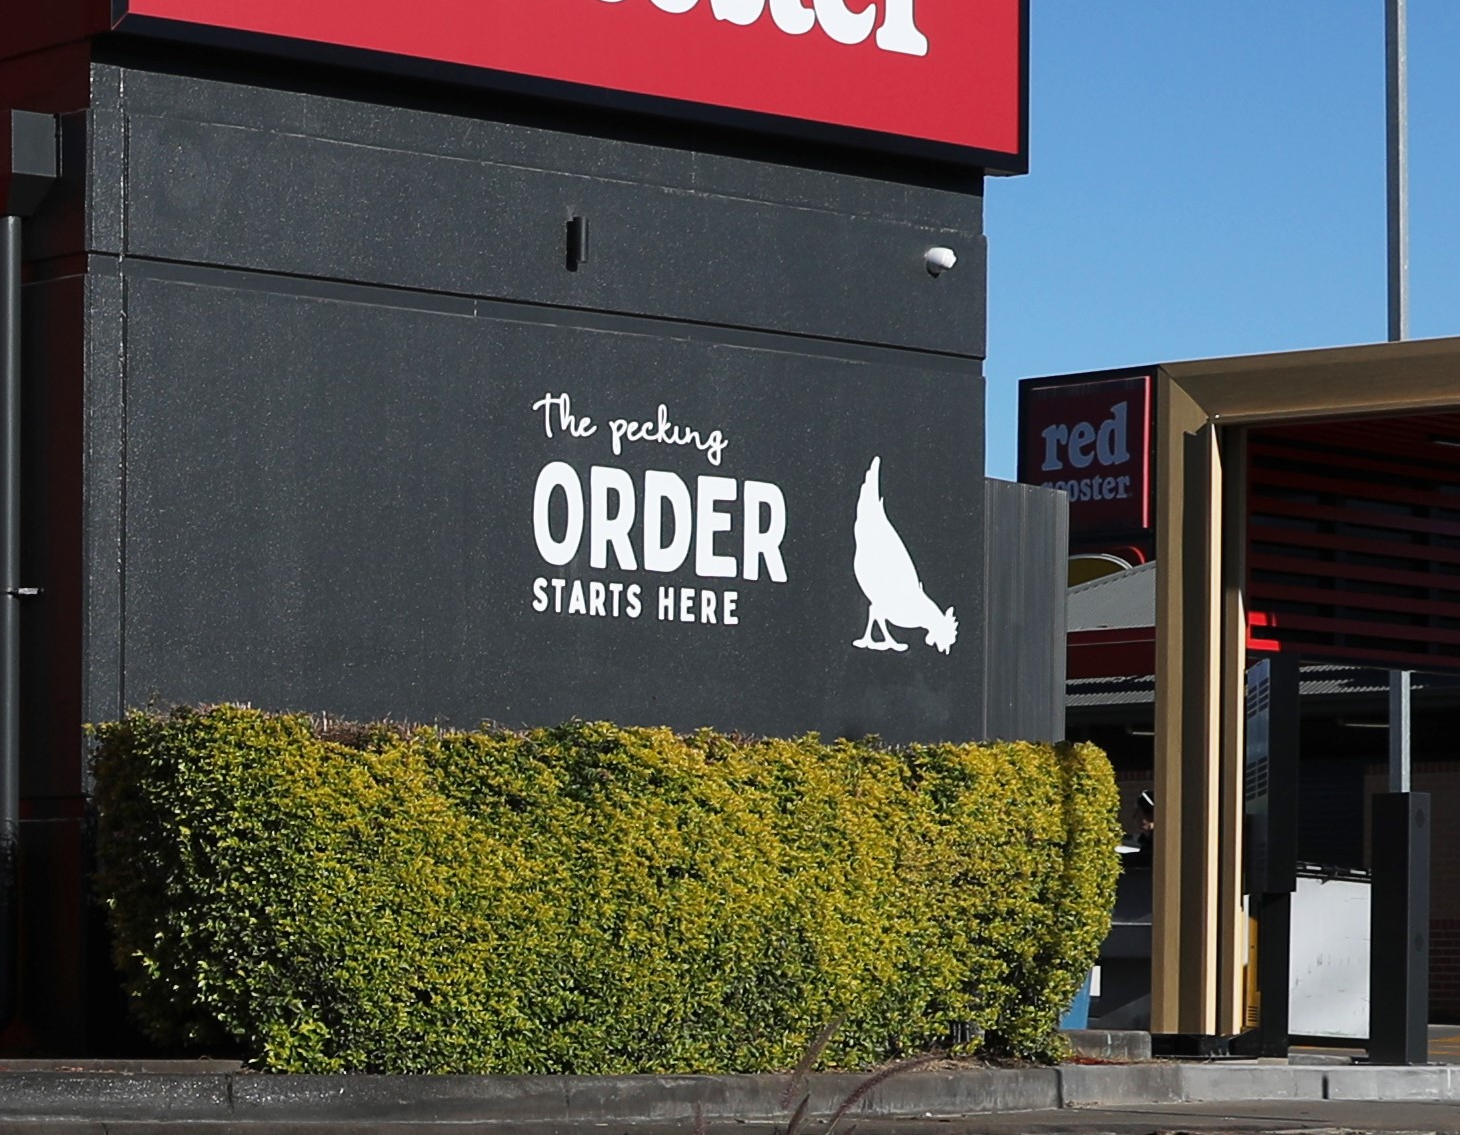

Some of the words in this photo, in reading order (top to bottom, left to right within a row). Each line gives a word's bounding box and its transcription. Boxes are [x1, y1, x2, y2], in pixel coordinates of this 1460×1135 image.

[532, 392, 598, 439] The
[608, 403, 730, 466] pecking
[1041, 400, 1131, 472] red
[532, 460, 789, 583] ORDER
[532, 577, 642, 618] STARTS
[658, 586, 740, 625] HERE
